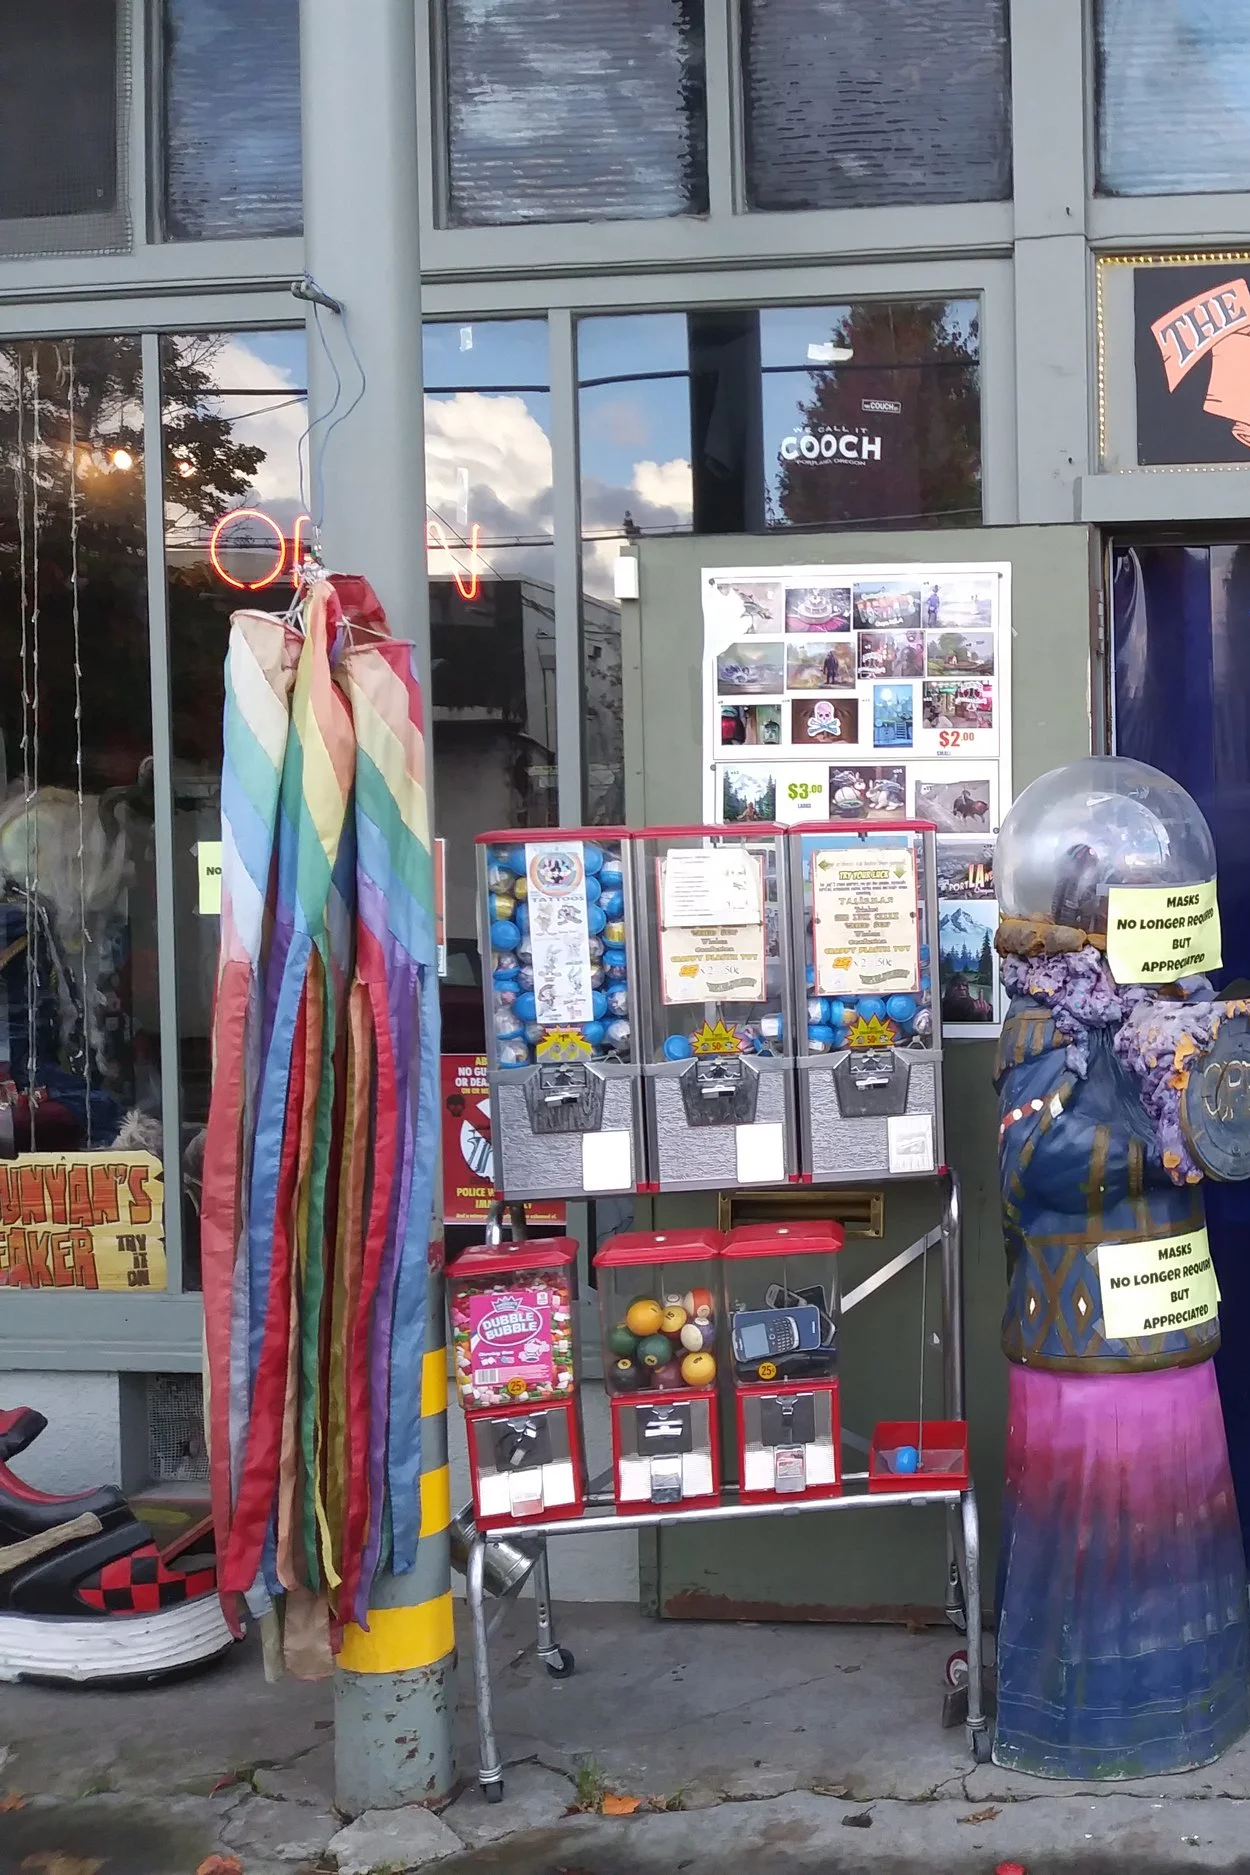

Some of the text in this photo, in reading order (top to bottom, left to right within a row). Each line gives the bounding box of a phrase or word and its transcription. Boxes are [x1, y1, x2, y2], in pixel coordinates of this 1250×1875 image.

[1160, 287, 1247, 368] THE
[817, 425, 849, 433] CALL
[781, 434, 882, 461] COOCH
[210, 509, 481, 600] ON
[939, 730, 974, 748] $2.00
[788, 783, 822, 800] $3.00
[206, 866, 223, 876] NO
[1166, 893, 1200, 908] MASKS
[1117, 919, 1136, 930] NO
[1140, 916, 1185, 930] LONGER
[1172, 937, 1191, 949] BUT
[1141, 953, 1205, 972] APPRECIATED
[458, 1067, 487, 1077] NO GU
[455, 1077, 489, 1087] OR DEA
[0, 1163, 152, 1225] UNYAN'S
[456, 1187, 485, 1197] POLICE
[116, 1234, 147, 1252] TRY
[1158, 1242, 1192, 1260] MASKS
[133, 1252, 148, 1269] IT
[127, 1269, 150, 1287] ON
[1110, 1257, 1211, 1289] NO LONGER REQUIR
[1170, 1288, 1190, 1302] BUT
[482, 1311, 534, 1331] DUBBLE
[1143, 1303, 1208, 1330] APPRECIATED
[485, 1321, 537, 1340] BUBBLE
[761, 1365, 775, 1377] 25¢
